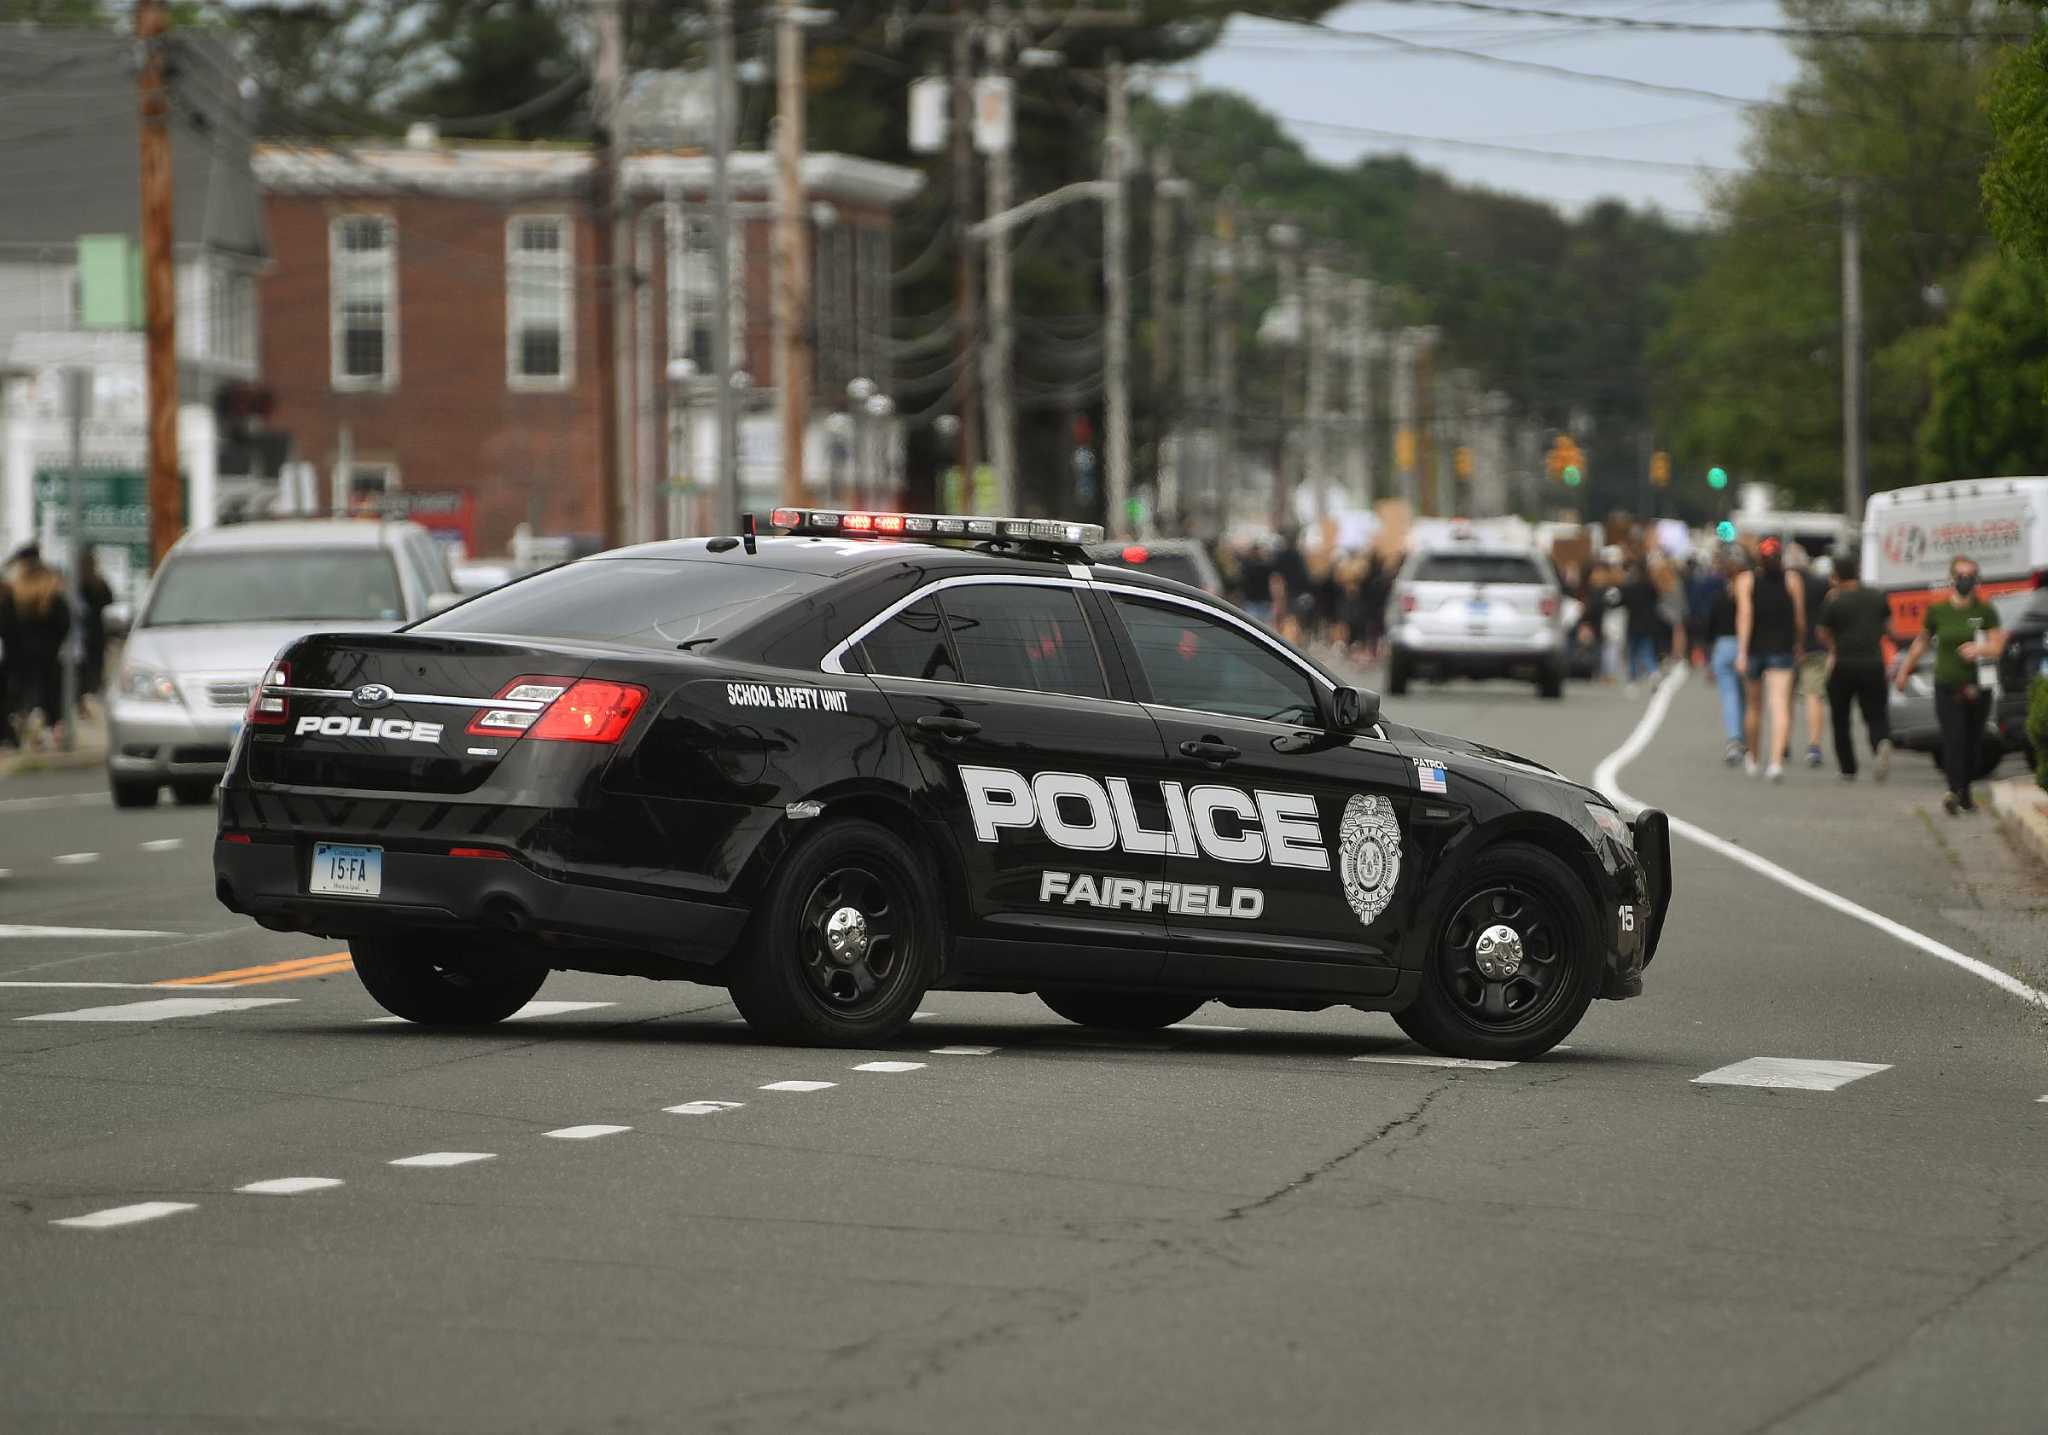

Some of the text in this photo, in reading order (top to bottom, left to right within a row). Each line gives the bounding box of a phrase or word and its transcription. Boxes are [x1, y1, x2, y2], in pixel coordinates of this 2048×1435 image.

[727, 683, 848, 713] SCHOOL SAFETY UNIT
[295, 716, 444, 744] POLICE
[1412, 757, 1448, 770] PATROL
[957, 764, 1331, 871] POLICE
[1039, 870, 1265, 919] FAIRFIELD
[1618, 905, 1634, 931] 15
